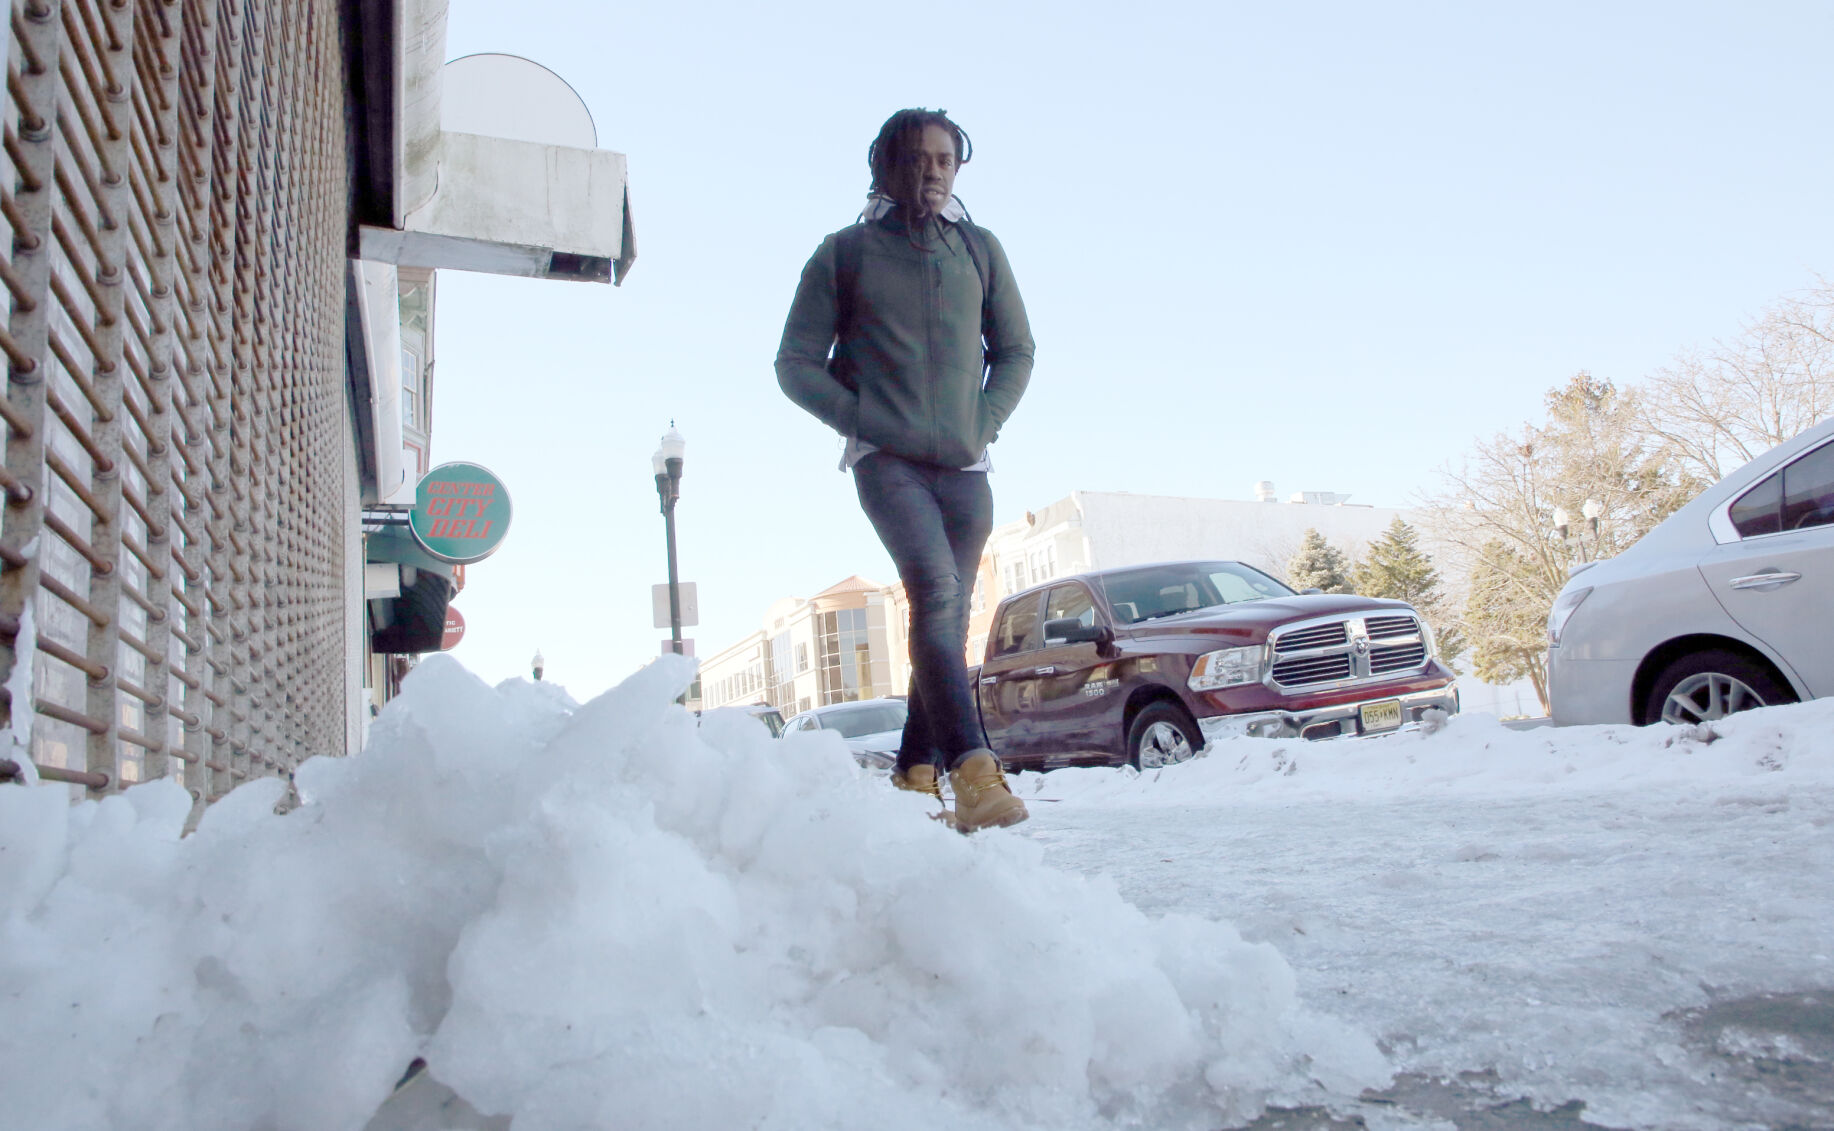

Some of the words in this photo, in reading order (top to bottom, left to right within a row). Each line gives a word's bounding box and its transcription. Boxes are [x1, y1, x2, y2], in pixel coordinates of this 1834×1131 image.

[427, 481, 496, 497] CENTER
[426, 497, 495, 517] CITY
[426, 518, 495, 538] DELI
